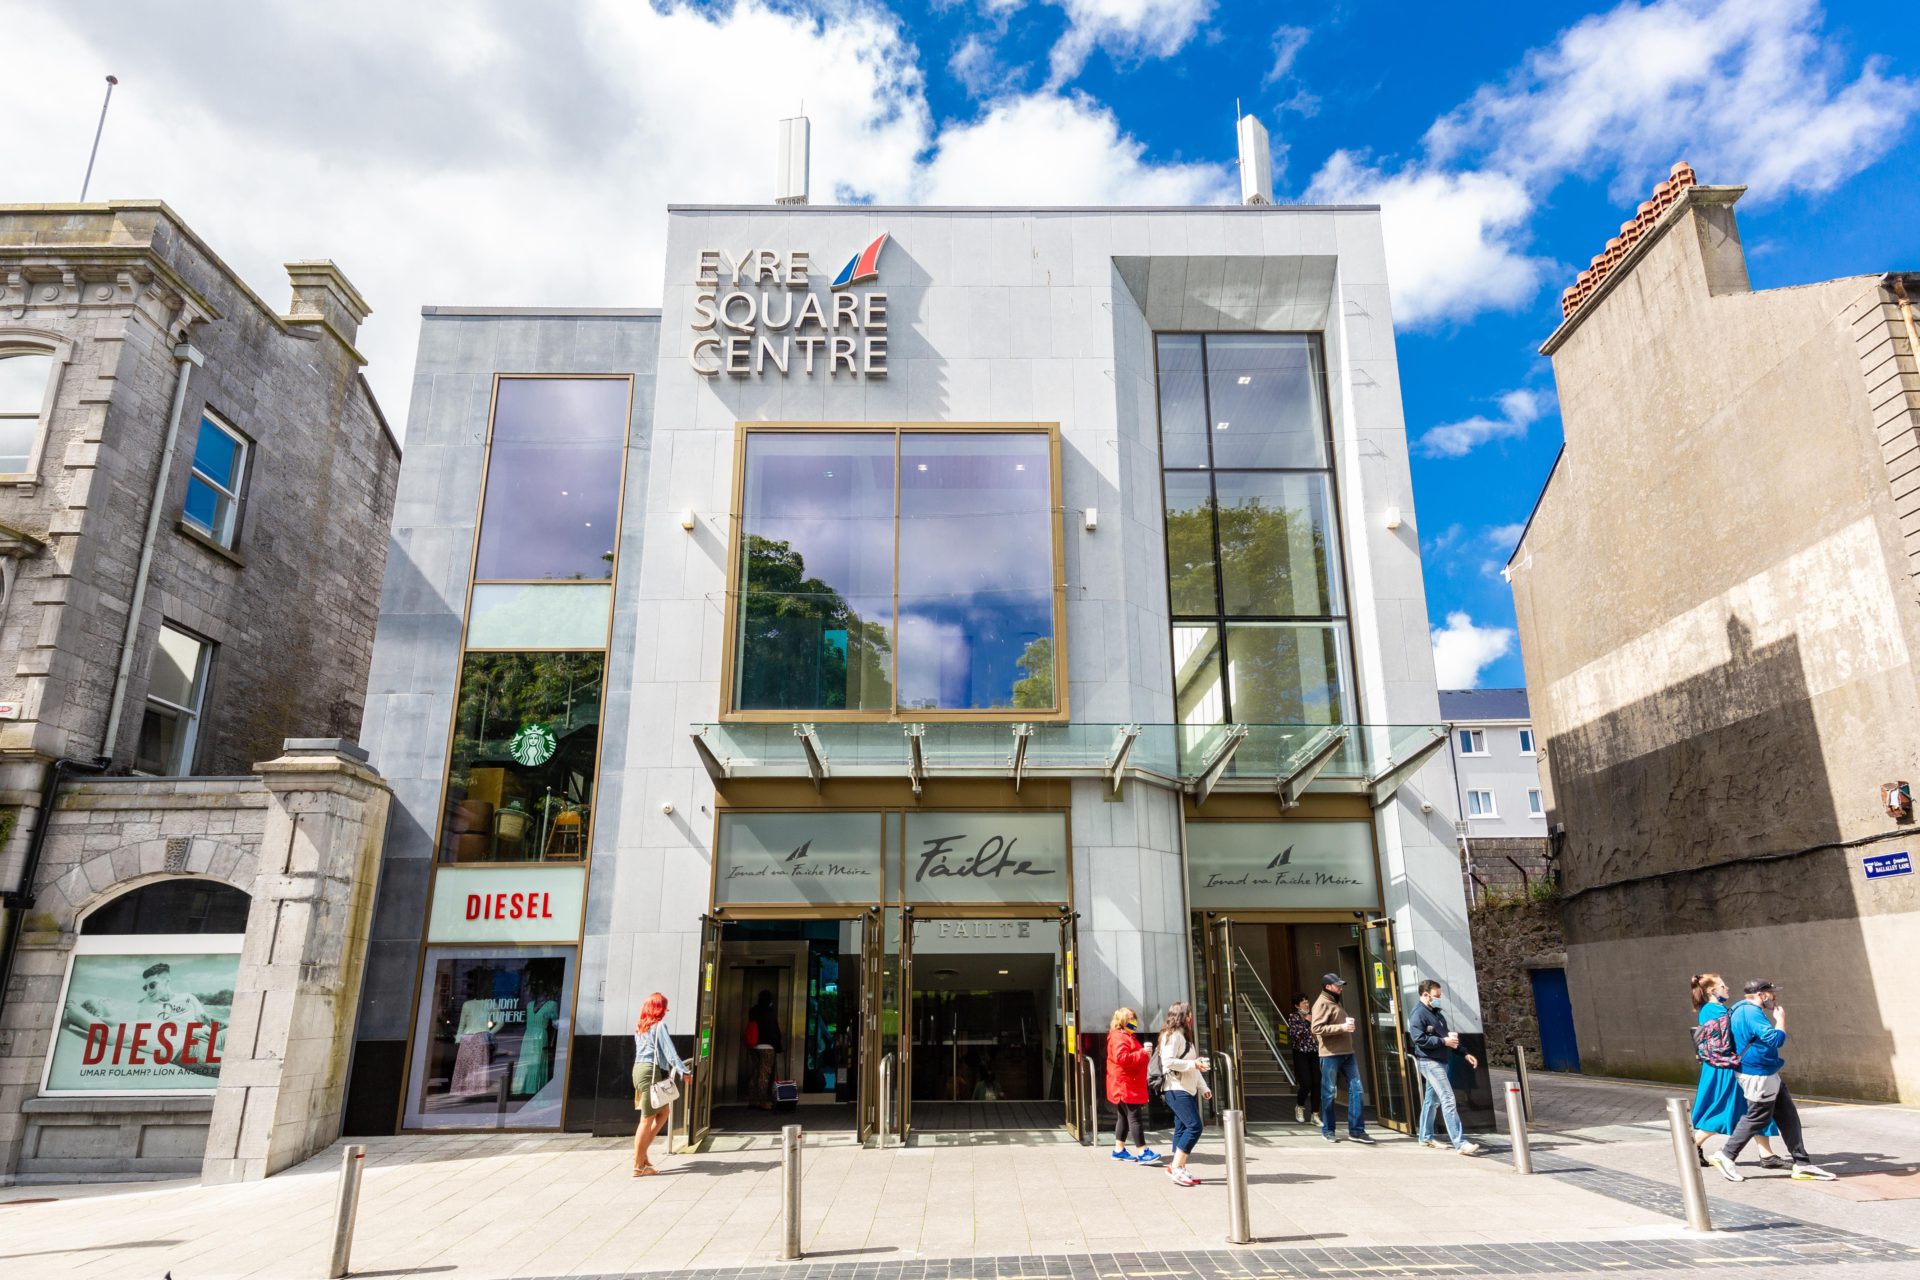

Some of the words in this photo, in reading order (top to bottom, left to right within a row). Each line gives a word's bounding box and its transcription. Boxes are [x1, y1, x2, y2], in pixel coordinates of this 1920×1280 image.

[696, 248, 809, 287] EYRE
[691, 292, 887, 335] SQUARE
[688, 336, 887, 375] CENTRE
[725, 865, 769, 879] Ionad
[791, 863, 824, 877] Faiche
[1203, 873, 1249, 888] Ionad
[1275, 871, 1311, 886] Faiche
[466, 892, 553, 921] DIESEL
[82, 1022, 222, 1066] DIESEL
[80, 1069, 106, 1077] UMAR
[109, 1068, 152, 1077] FOLAMH?
